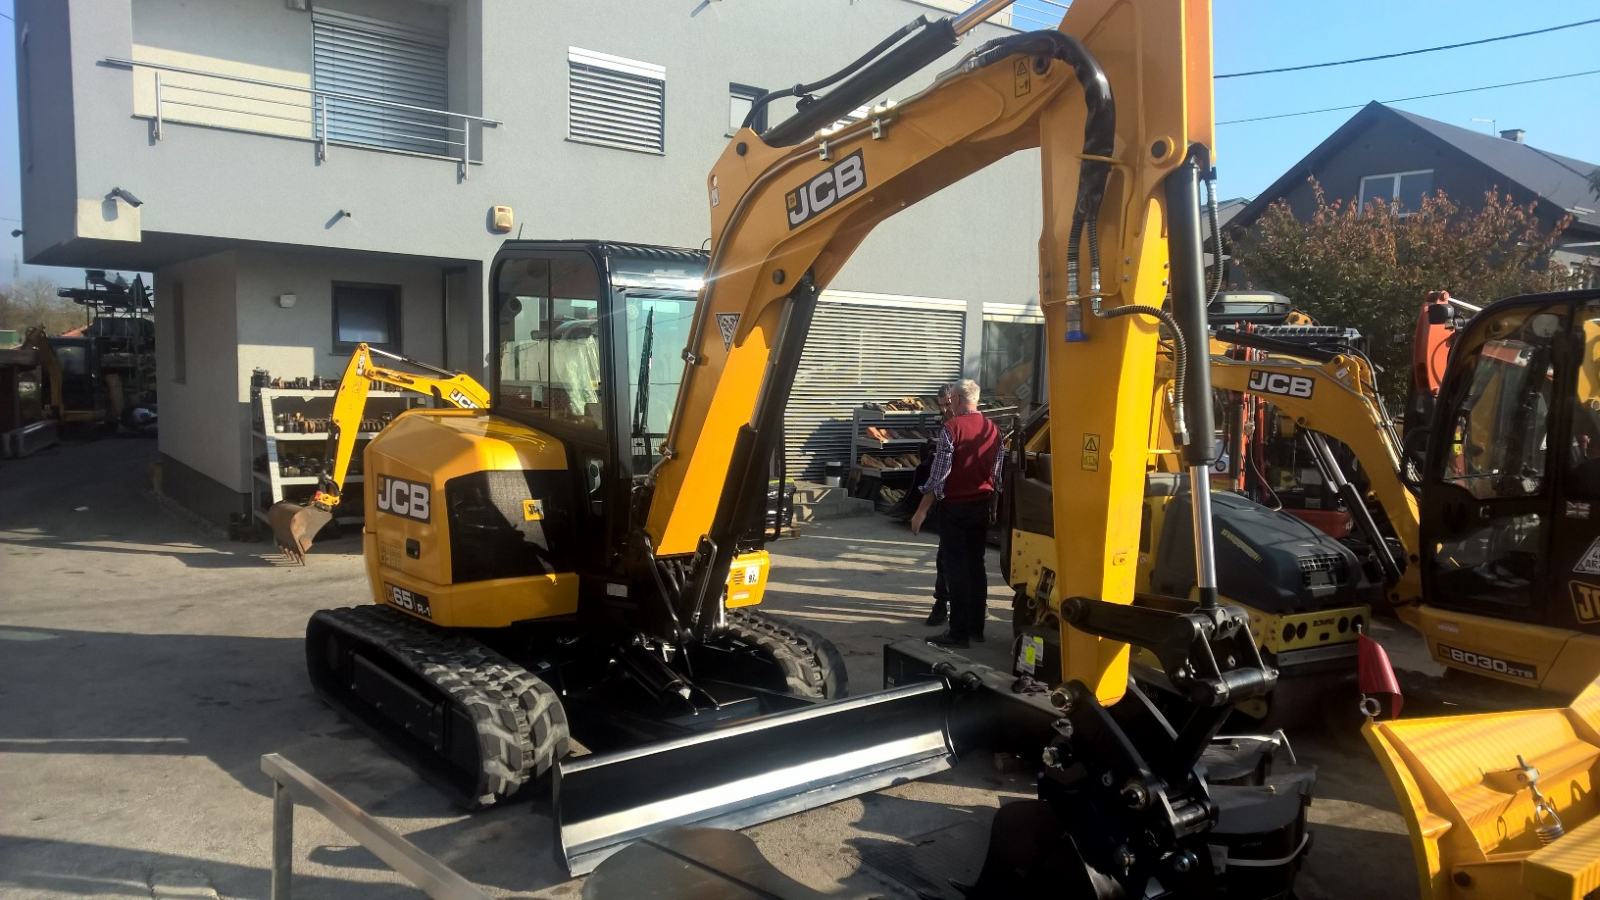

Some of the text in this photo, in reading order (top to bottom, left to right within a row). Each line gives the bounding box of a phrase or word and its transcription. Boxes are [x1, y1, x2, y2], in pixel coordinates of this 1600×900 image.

[789, 155, 864, 224] JCB
[1250, 372, 1313, 397] JCB
[378, 479, 429, 519] JCB
[393, 586, 413, 610] 65
